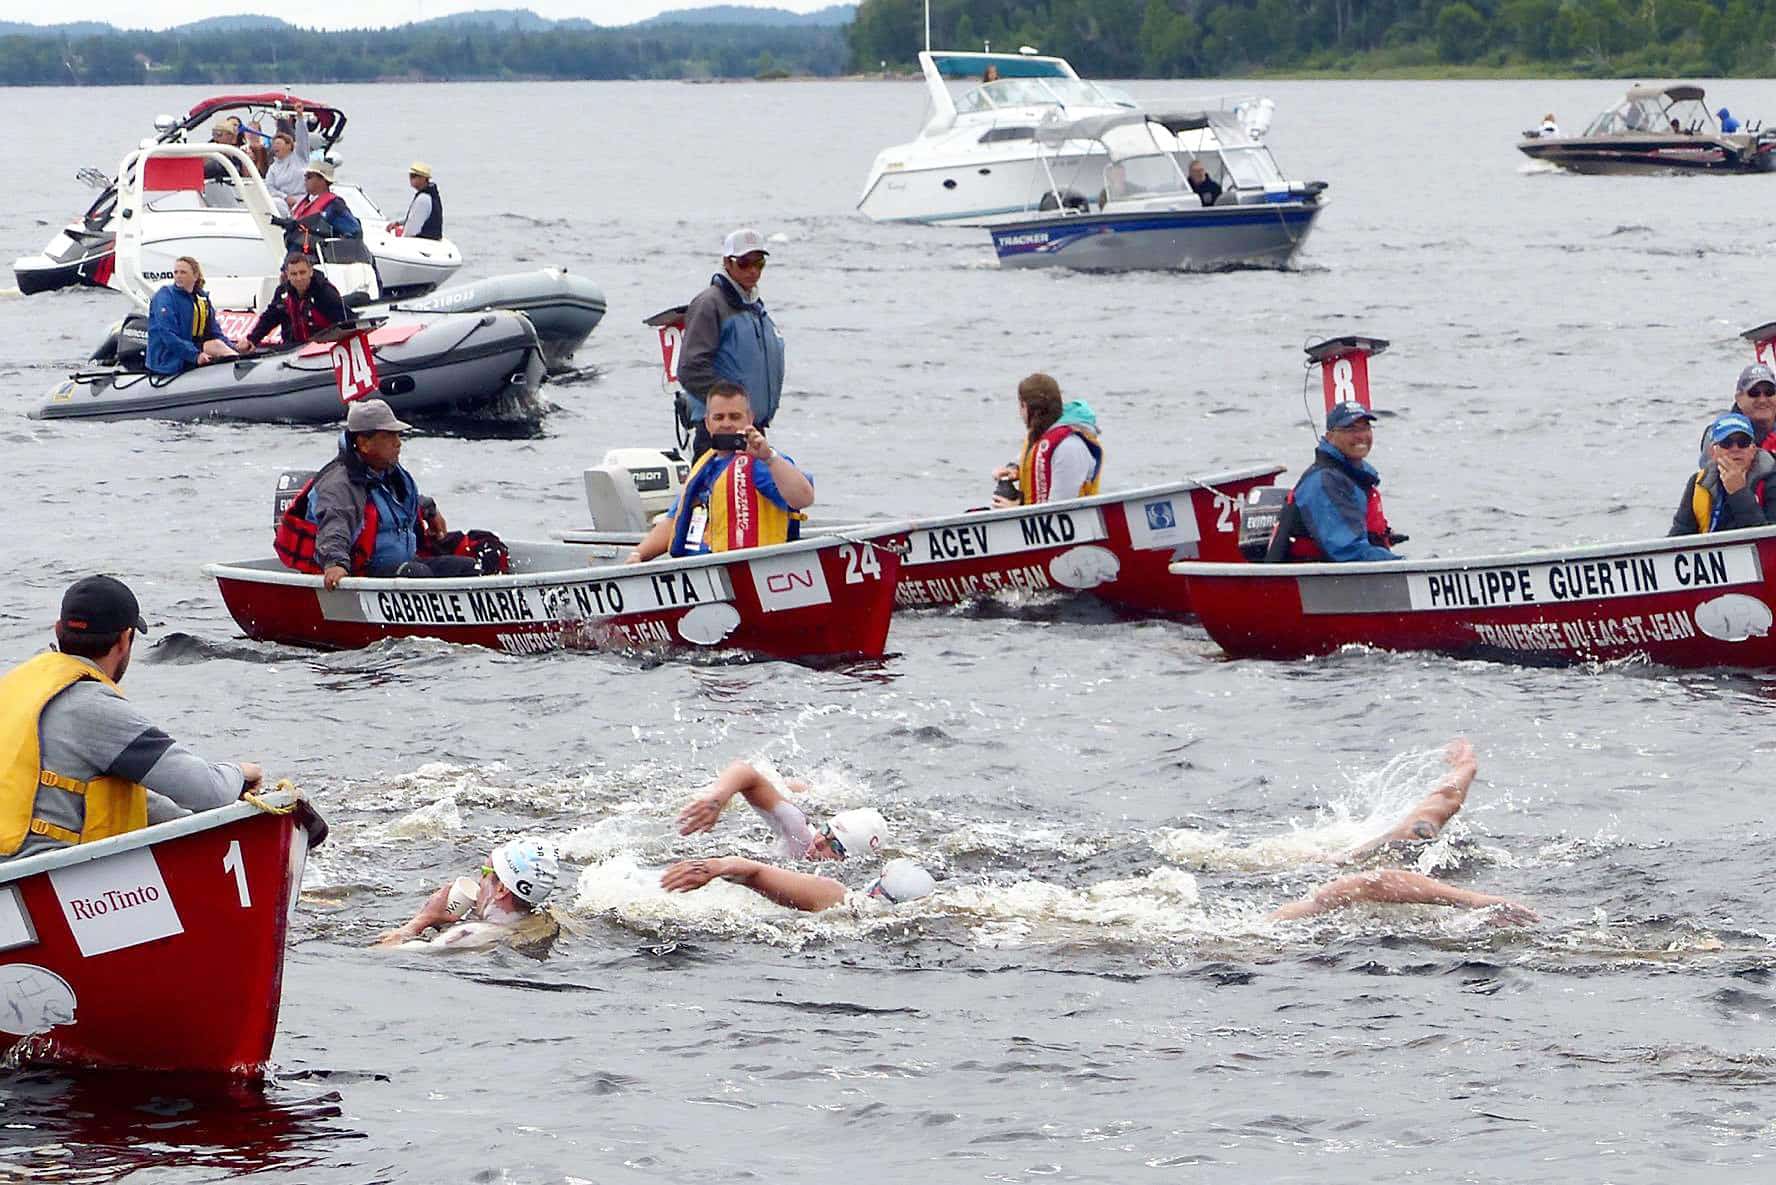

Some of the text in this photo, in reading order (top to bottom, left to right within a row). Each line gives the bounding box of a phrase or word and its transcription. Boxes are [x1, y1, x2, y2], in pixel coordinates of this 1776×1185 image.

[999, 233, 1049, 247] TRACKER
[333, 335, 373, 400] 24
[1333, 359, 1356, 405] 8
[928, 525, 990, 560] ACEV
[1019, 513, 1076, 546] MKD
[766, 568, 814, 593] CN
[838, 543, 882, 585] 24
[1427, 550, 1729, 607] PHILIPPE GUERTIN CAN
[377, 591, 466, 624] GABRIELE
[467, 589, 534, 622] MARIA
[650, 571, 700, 607] ITA
[222, 840, 252, 908] 1
